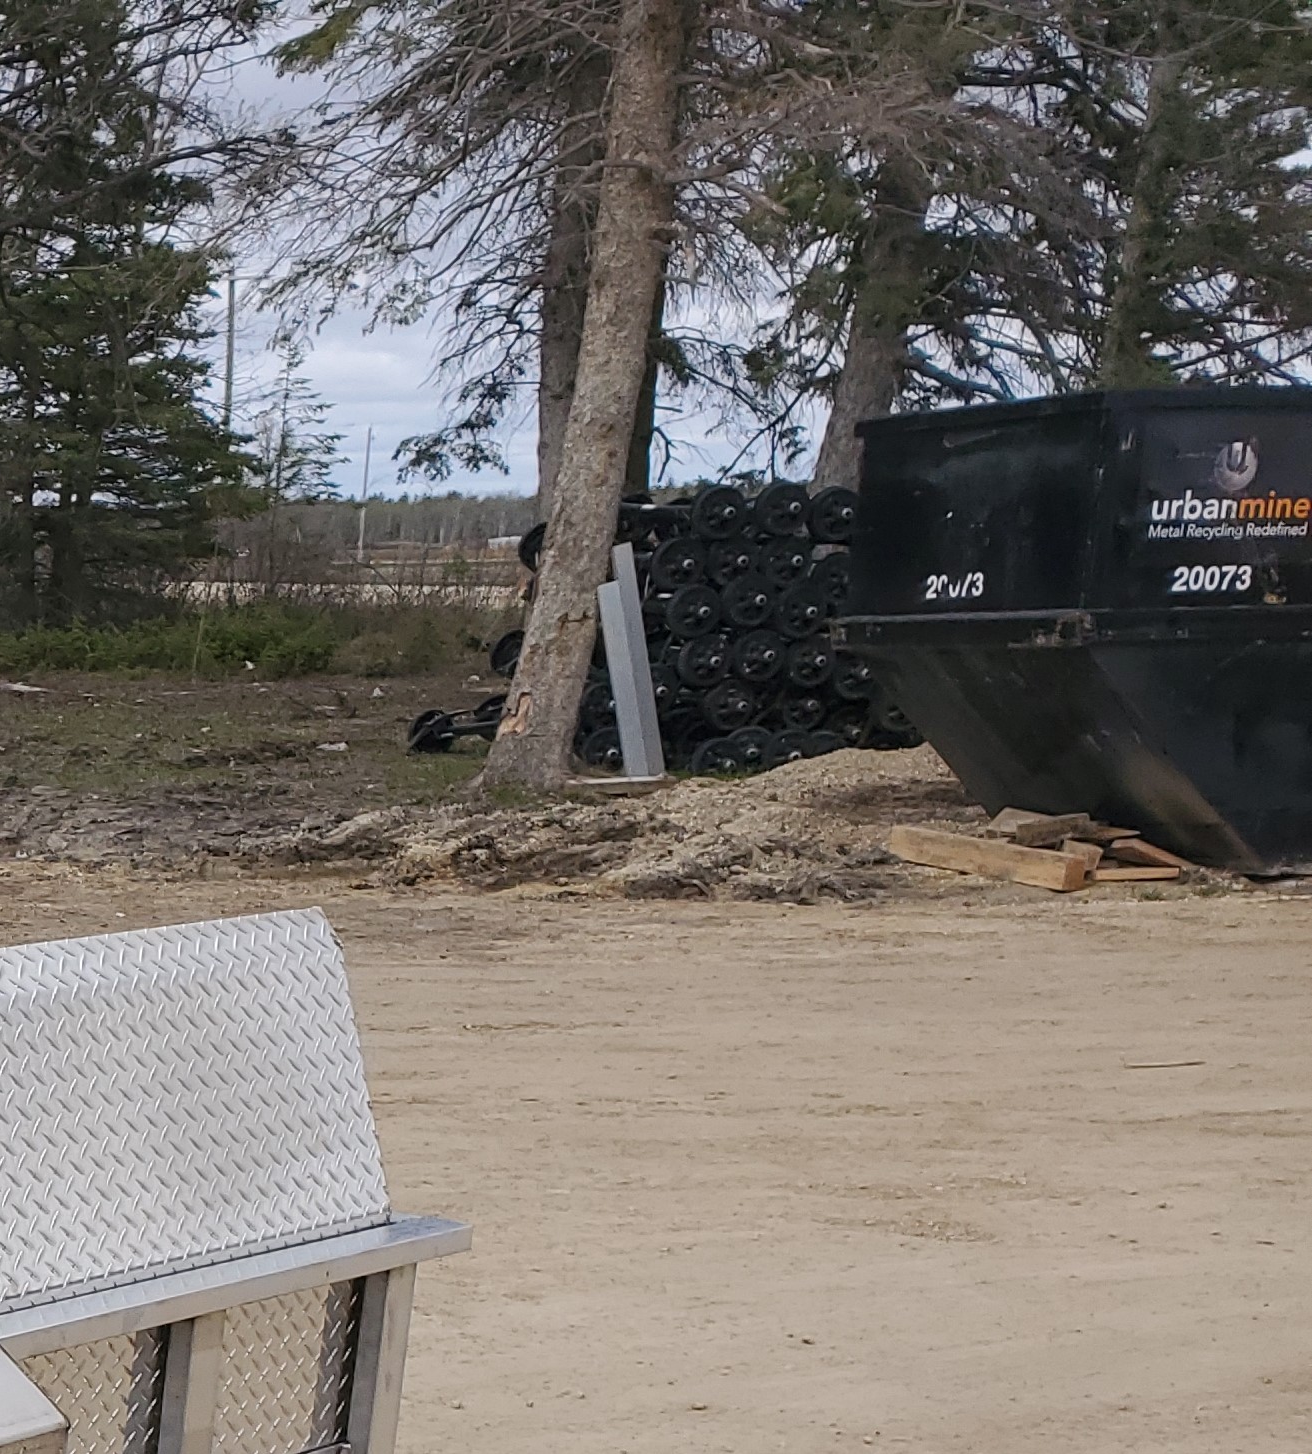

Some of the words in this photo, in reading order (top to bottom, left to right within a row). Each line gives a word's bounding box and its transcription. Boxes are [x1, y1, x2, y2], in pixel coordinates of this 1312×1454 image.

[1151, 489, 1311, 521] urbanmine
[1148, 523, 1184, 539] Metal
[1186, 522, 1243, 541] Recycling
[1245, 521, 1309, 538] Redefined
[1171, 564, 1253, 592] 20073
